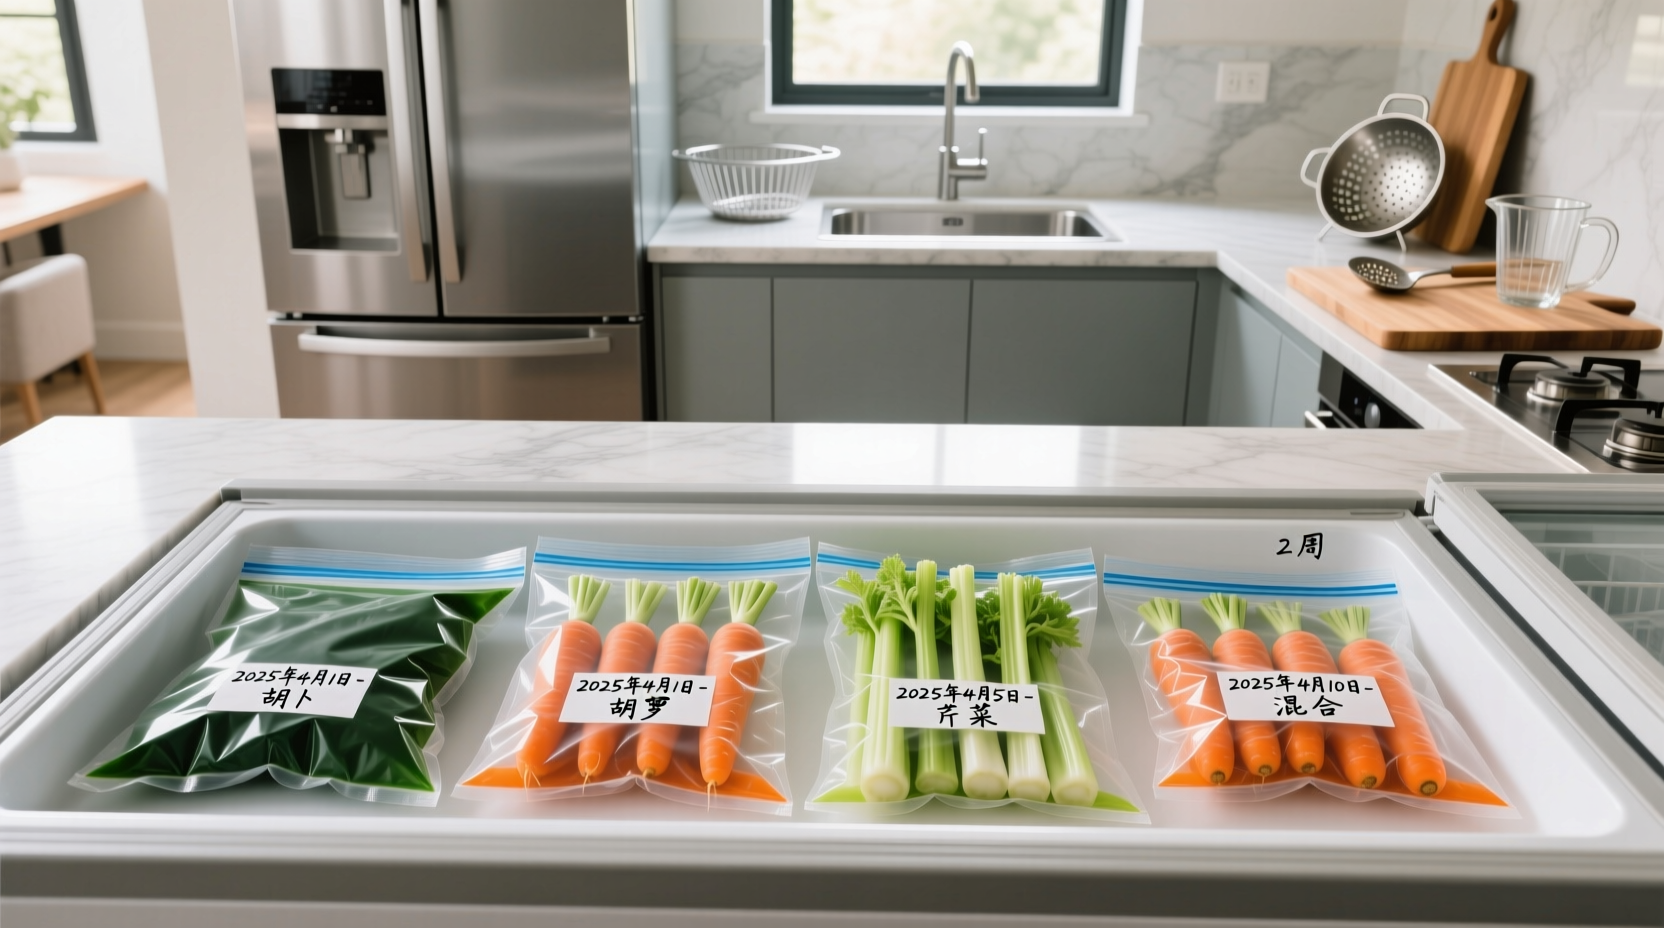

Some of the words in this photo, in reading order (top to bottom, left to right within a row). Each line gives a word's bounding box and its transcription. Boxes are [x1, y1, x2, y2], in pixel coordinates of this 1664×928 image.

[231, 666, 365, 686] 2025年4月1日-
[576, 675, 708, 695] 2025年4月1日-
[1228, 673, 1374, 694] 2025年4月10日-
[896, 683, 1034, 703] 2025年4月5日-
[936, 703, 998, 728] 芹菜
[1273, 695, 1343, 716] 混合
